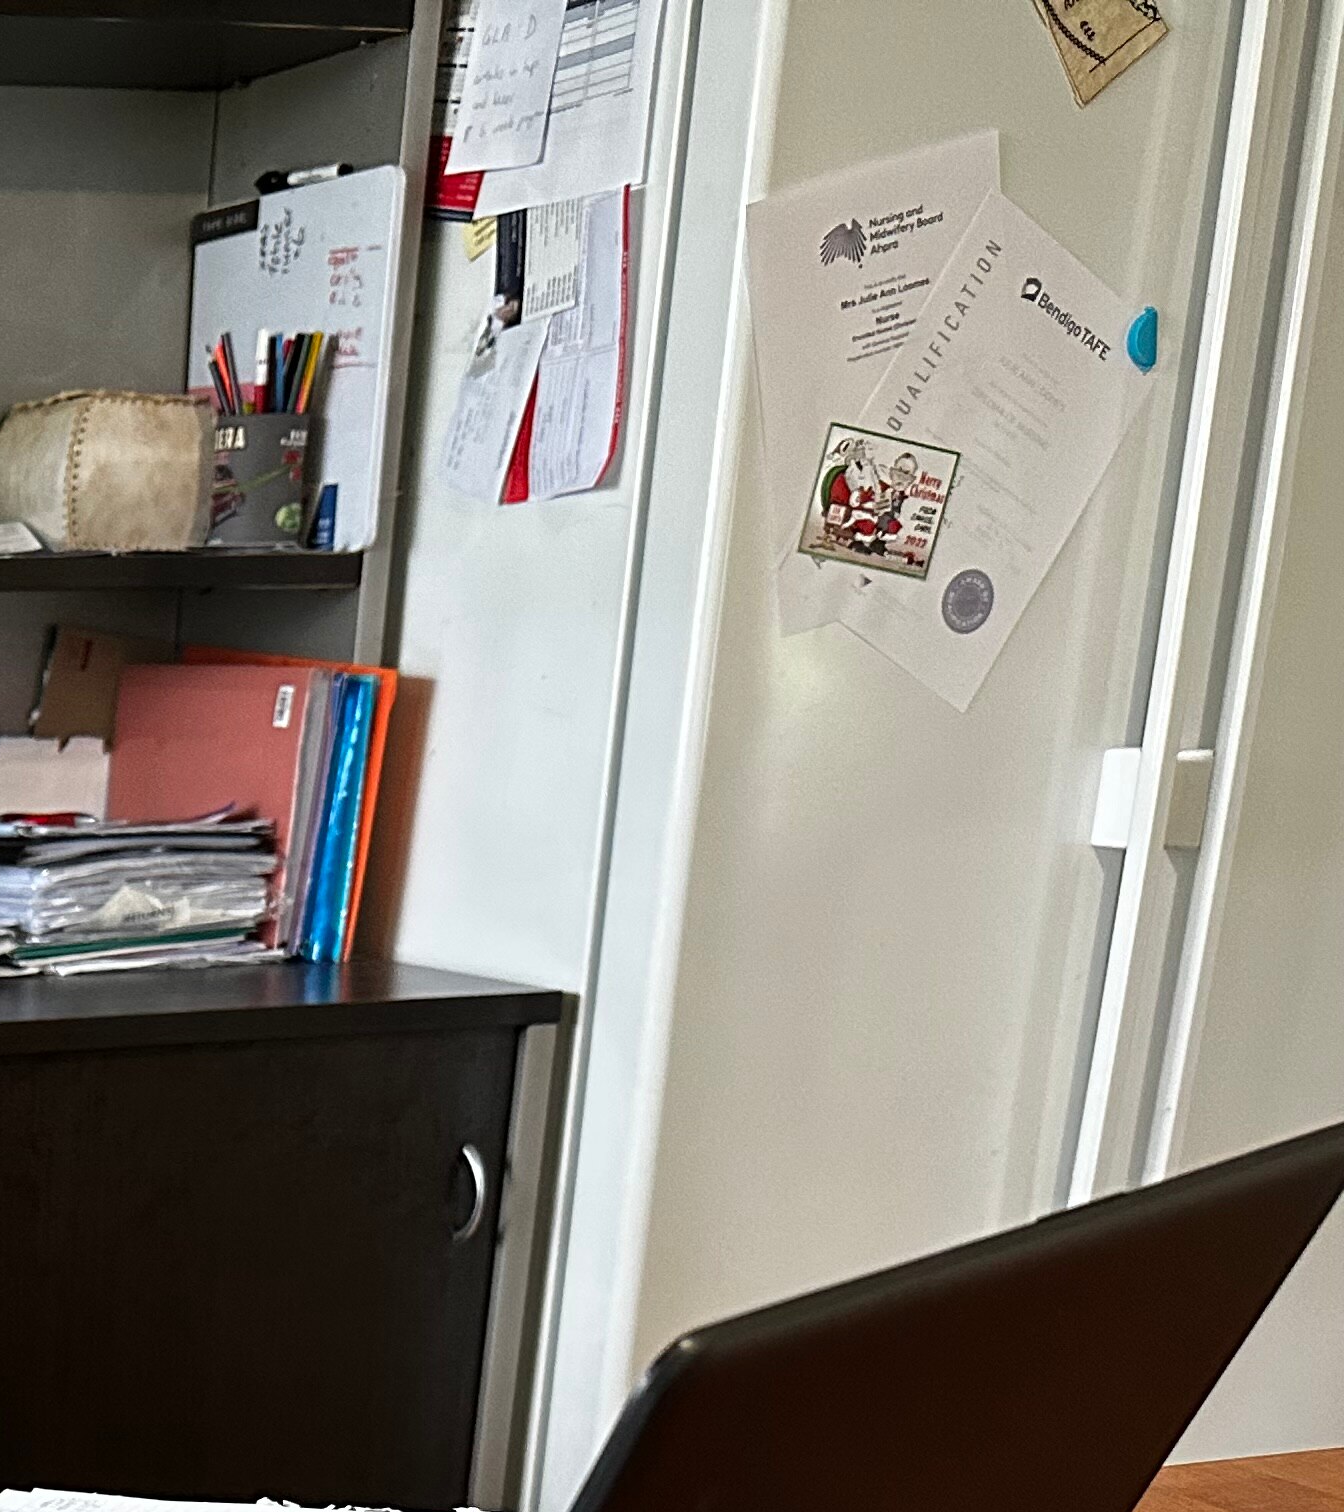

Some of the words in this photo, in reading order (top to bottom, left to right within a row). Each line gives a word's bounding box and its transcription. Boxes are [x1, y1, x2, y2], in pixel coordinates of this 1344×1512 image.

[869, 212, 904, 228] Nursing
[906, 204, 923, 217] and
[869, 223, 914, 241] Midwifery
[917, 212, 943, 228] Board
[886, 240, 1002, 431] QUALIFICATION
[1037, 293, 1082, 337] Bendigo
[1080, 327, 1110, 361] TAFE
[920, 471, 942, 490] Merry
[910, 484, 945, 504] Christmas
